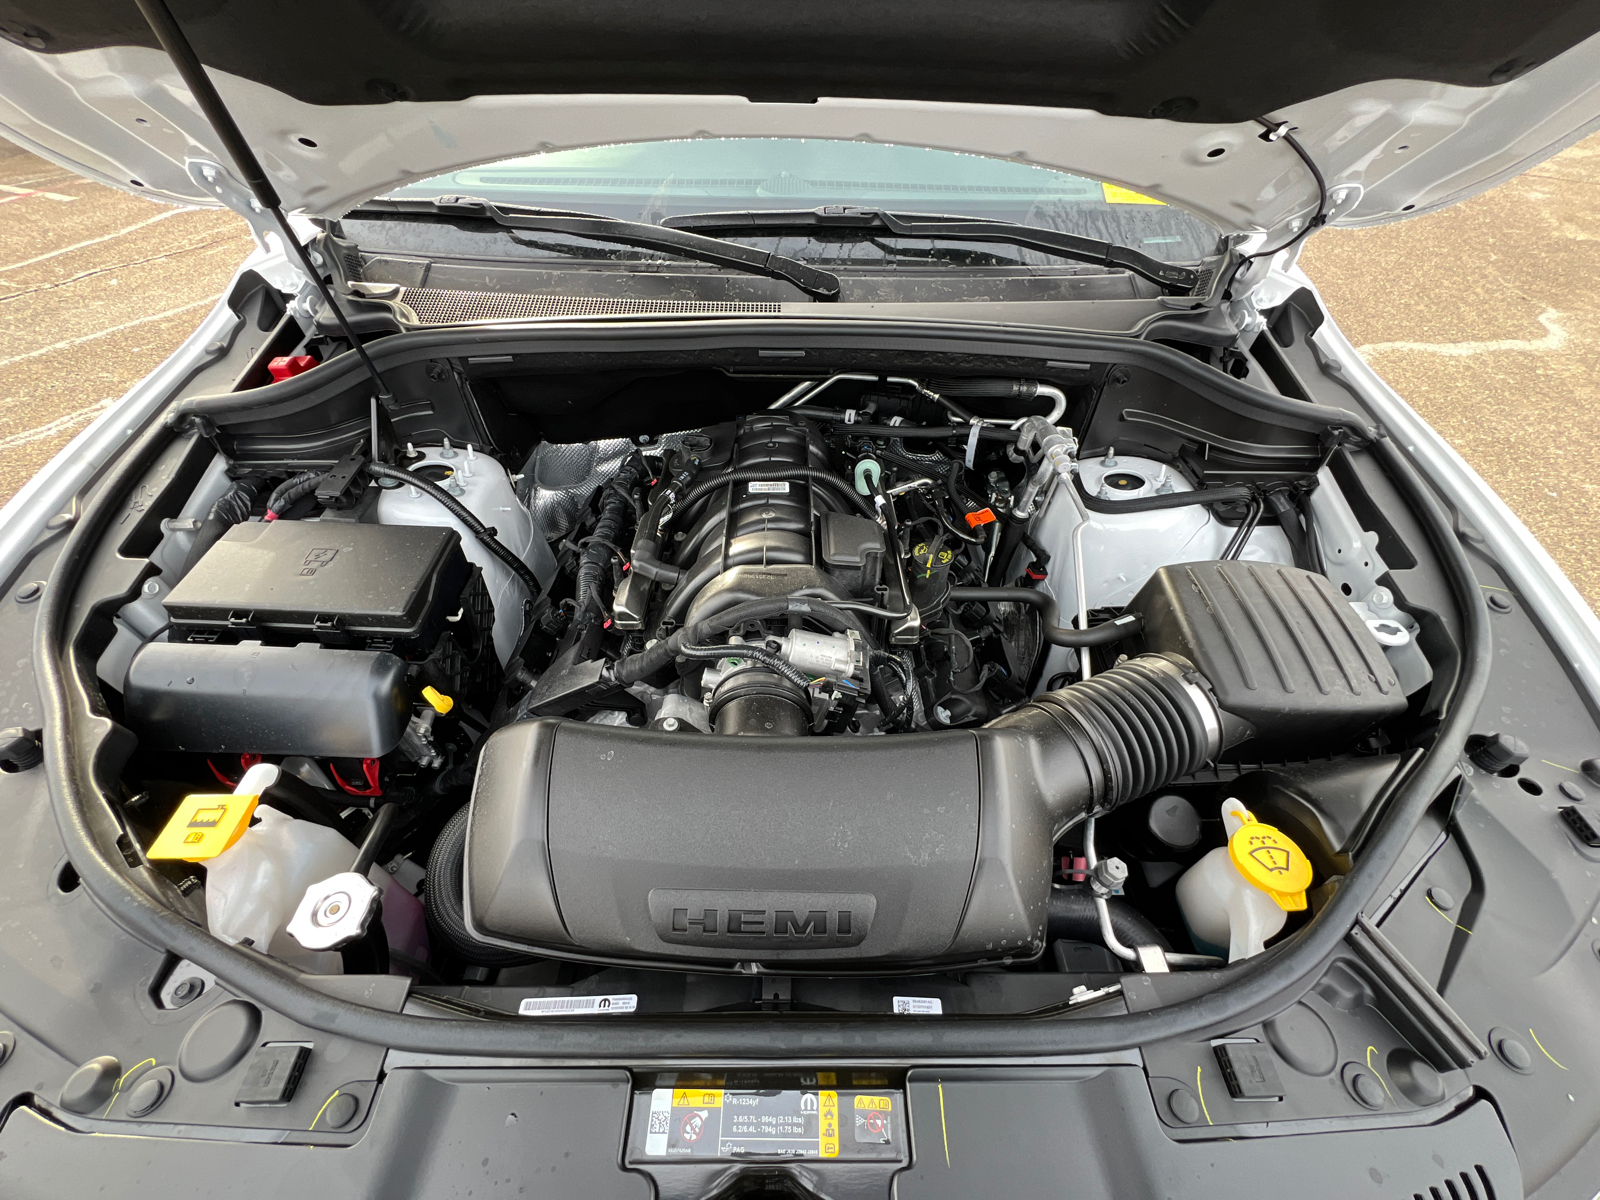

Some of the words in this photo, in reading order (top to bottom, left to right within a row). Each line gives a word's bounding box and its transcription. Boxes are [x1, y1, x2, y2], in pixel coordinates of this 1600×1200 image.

[672, 908, 852, 936] HEMI
[732, 1098, 759, 1107] R-1234yf
[733, 1115, 757, 1123] 3.6/5.7L
[777, 1116, 792, 1124] (2.13
[792, 1116, 804, 1125] lbs)
[732, 1125, 757, 1133] 6.2/6.4L
[761, 1126, 776, 1134] 794g
[777, 1125, 792, 1134] (1.75
[792, 1125, 804, 1134] lbs)
